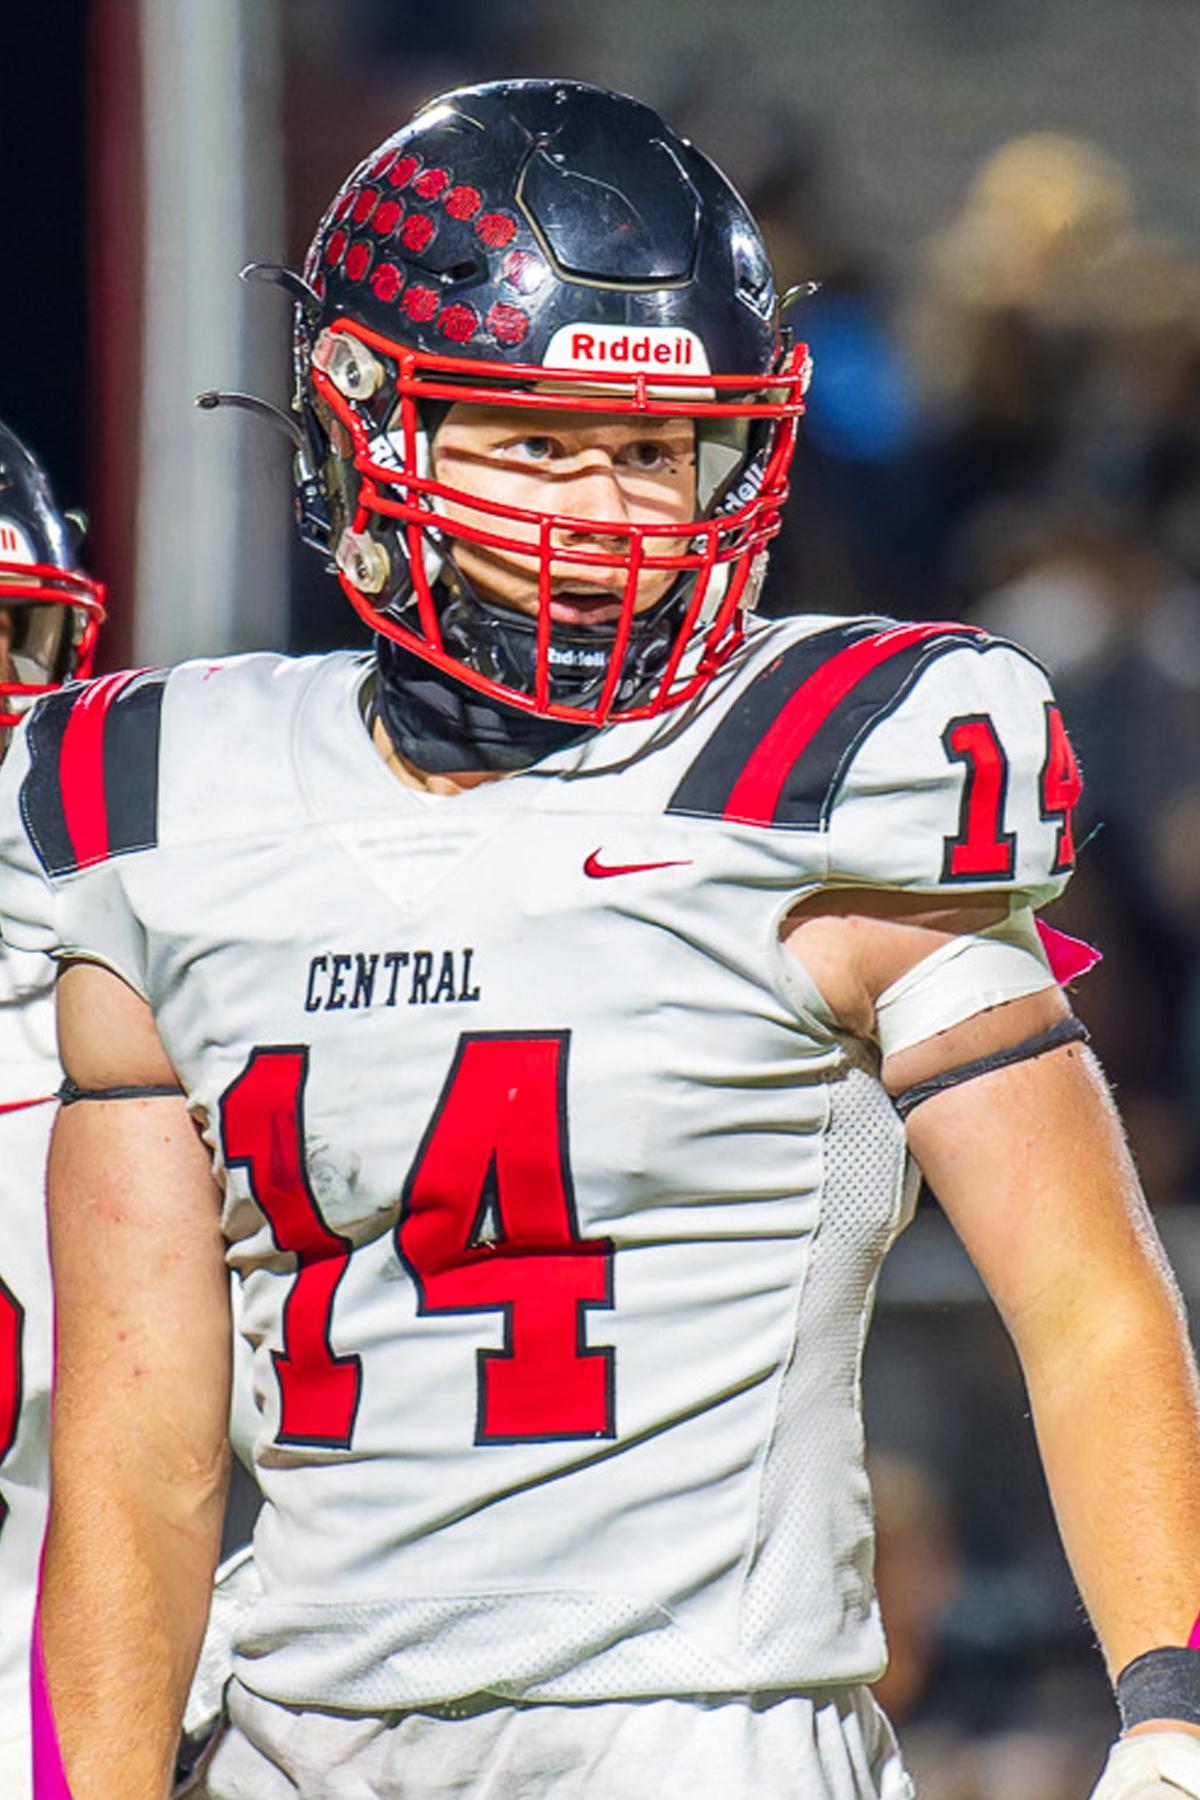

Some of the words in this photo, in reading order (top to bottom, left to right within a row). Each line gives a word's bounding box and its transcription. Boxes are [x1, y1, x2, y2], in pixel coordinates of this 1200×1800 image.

[571, 333, 692, 365] Riddell
[939, 700, 1083, 885] 14
[303, 947, 481, 1012] CENTRAL
[219, 1029, 617, 1448] 14
